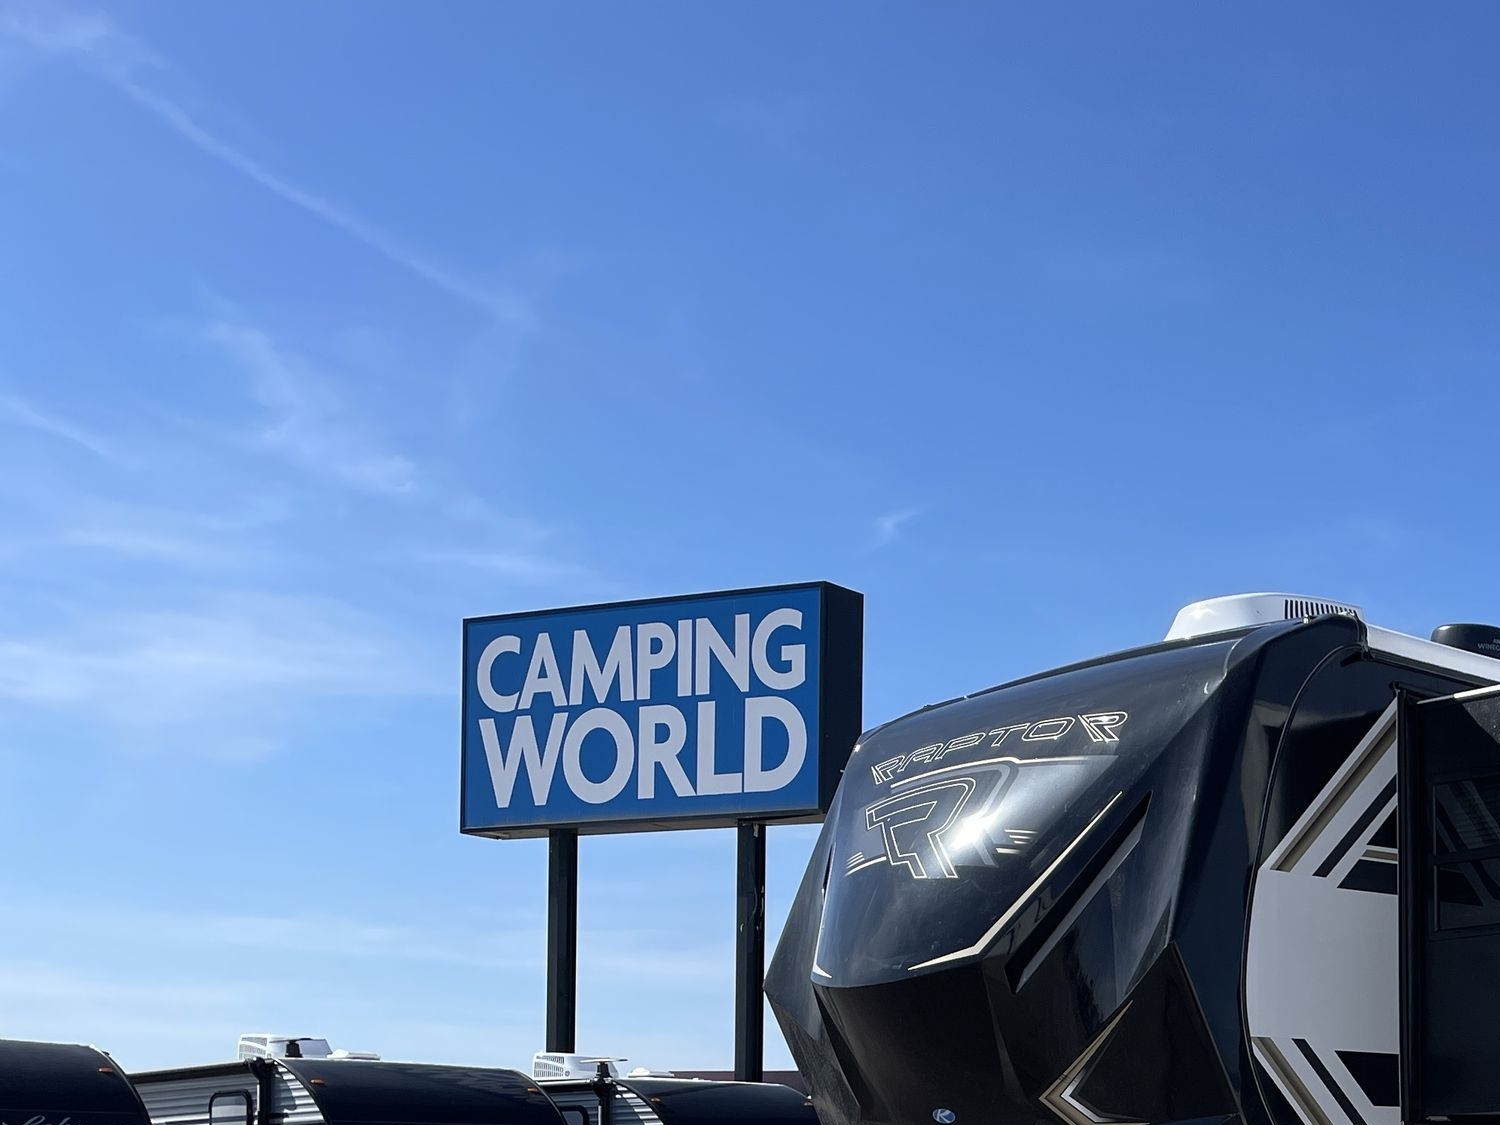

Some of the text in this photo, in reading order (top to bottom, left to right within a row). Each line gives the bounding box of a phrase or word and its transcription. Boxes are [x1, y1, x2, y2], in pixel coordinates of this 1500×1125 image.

[476, 608, 806, 713] CAMPING
[478, 695, 808, 809] WORLD
[871, 711, 1129, 785] RAPTOR
